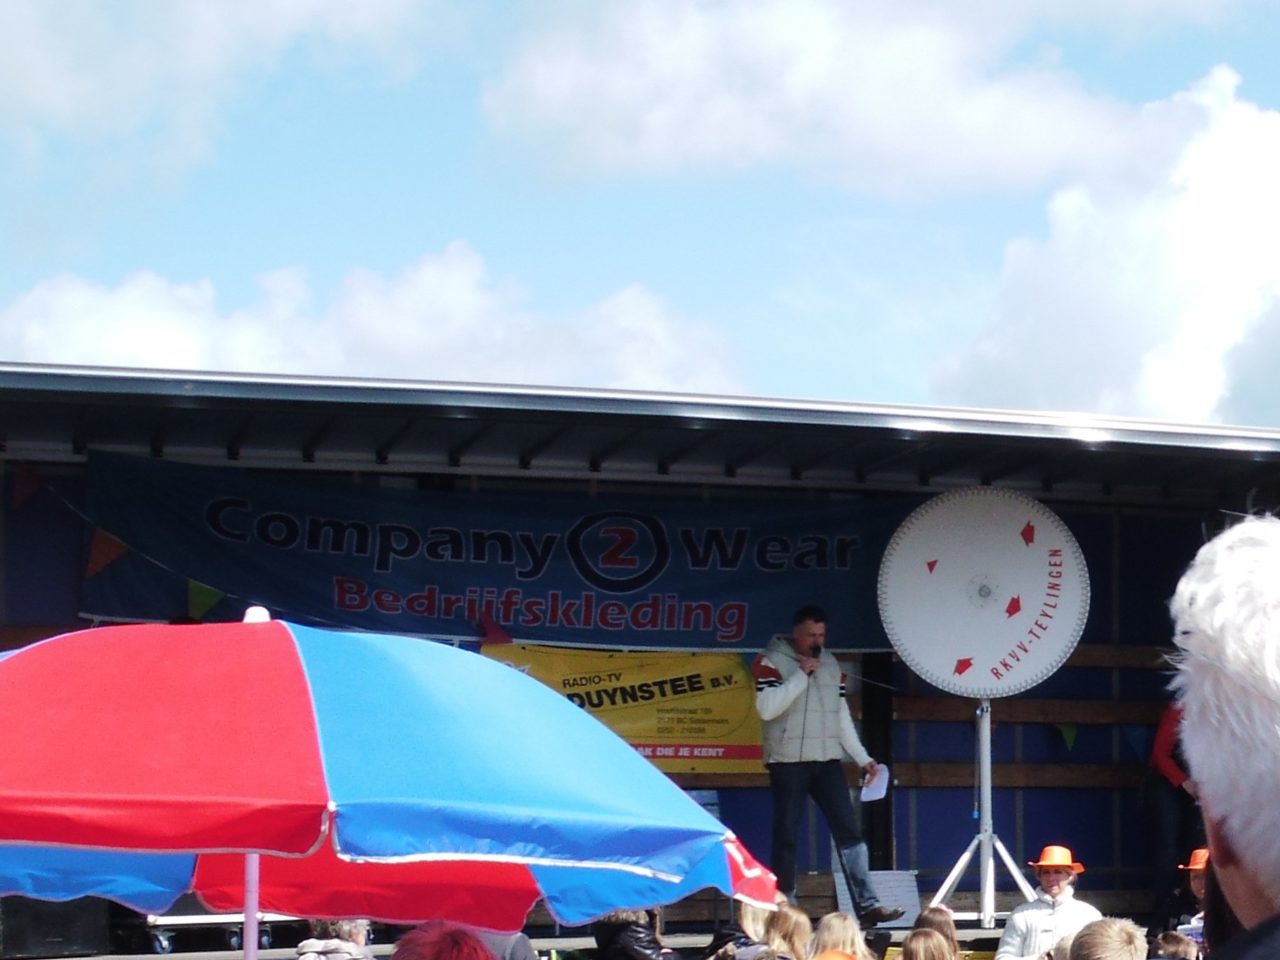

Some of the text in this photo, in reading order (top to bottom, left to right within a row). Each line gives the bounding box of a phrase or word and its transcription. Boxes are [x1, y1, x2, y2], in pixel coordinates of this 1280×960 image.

[204, 496, 861, 582] Company 2 Wear
[333, 575, 749, 641] Bedrijfskleding
[990, 548, 1063, 680] RKVV-TEYLINGEN
[562, 672, 622, 689] RADIO-TV
[566, 673, 738, 709] DUYNSTEE B.V.
[656, 747, 675, 756] DIE
[677, 747, 691, 756] JE
[693, 747, 725, 757] KENT
